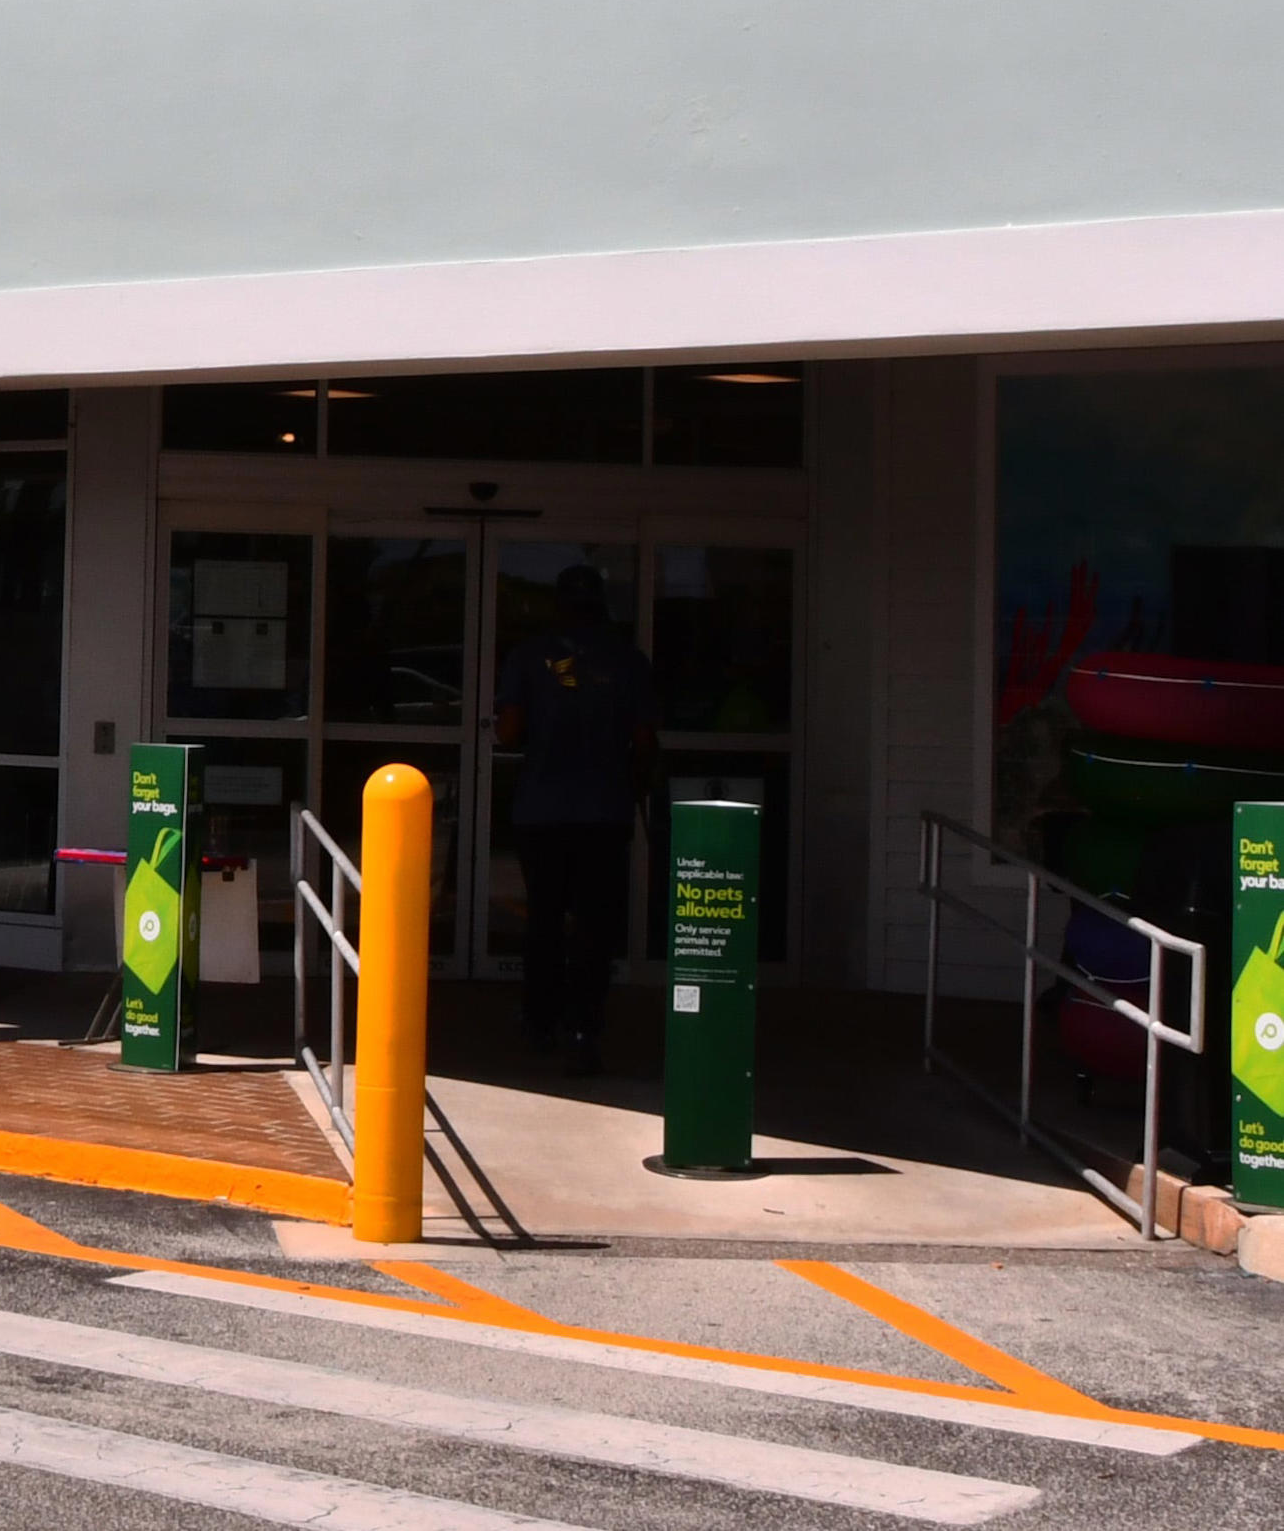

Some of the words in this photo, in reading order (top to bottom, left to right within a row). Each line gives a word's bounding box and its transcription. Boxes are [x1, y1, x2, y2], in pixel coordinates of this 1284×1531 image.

[133, 771, 157, 785] Don't
[133, 785, 160, 801] forget
[132, 801, 151, 814] your
[1240, 838, 1274, 856] Don't
[676, 857, 706, 868] Under
[1240, 855, 1280, 875] forget
[676, 869, 724, 880] applicable
[726, 870, 744, 881] law:
[1240, 875, 1269, 891] your
[676, 883, 702, 900] No
[704, 886, 743, 904] pets
[675, 901, 745, 919] allowed.
[674, 923, 698, 936] Only
[698, 925, 731, 936] service
[674, 935, 709, 945] animals
[711, 938, 727, 946] are
[674, 947, 723, 958] permitted.
[1239, 1120, 1265, 1136] Let's
[1256, 1138, 1284, 1154] good
